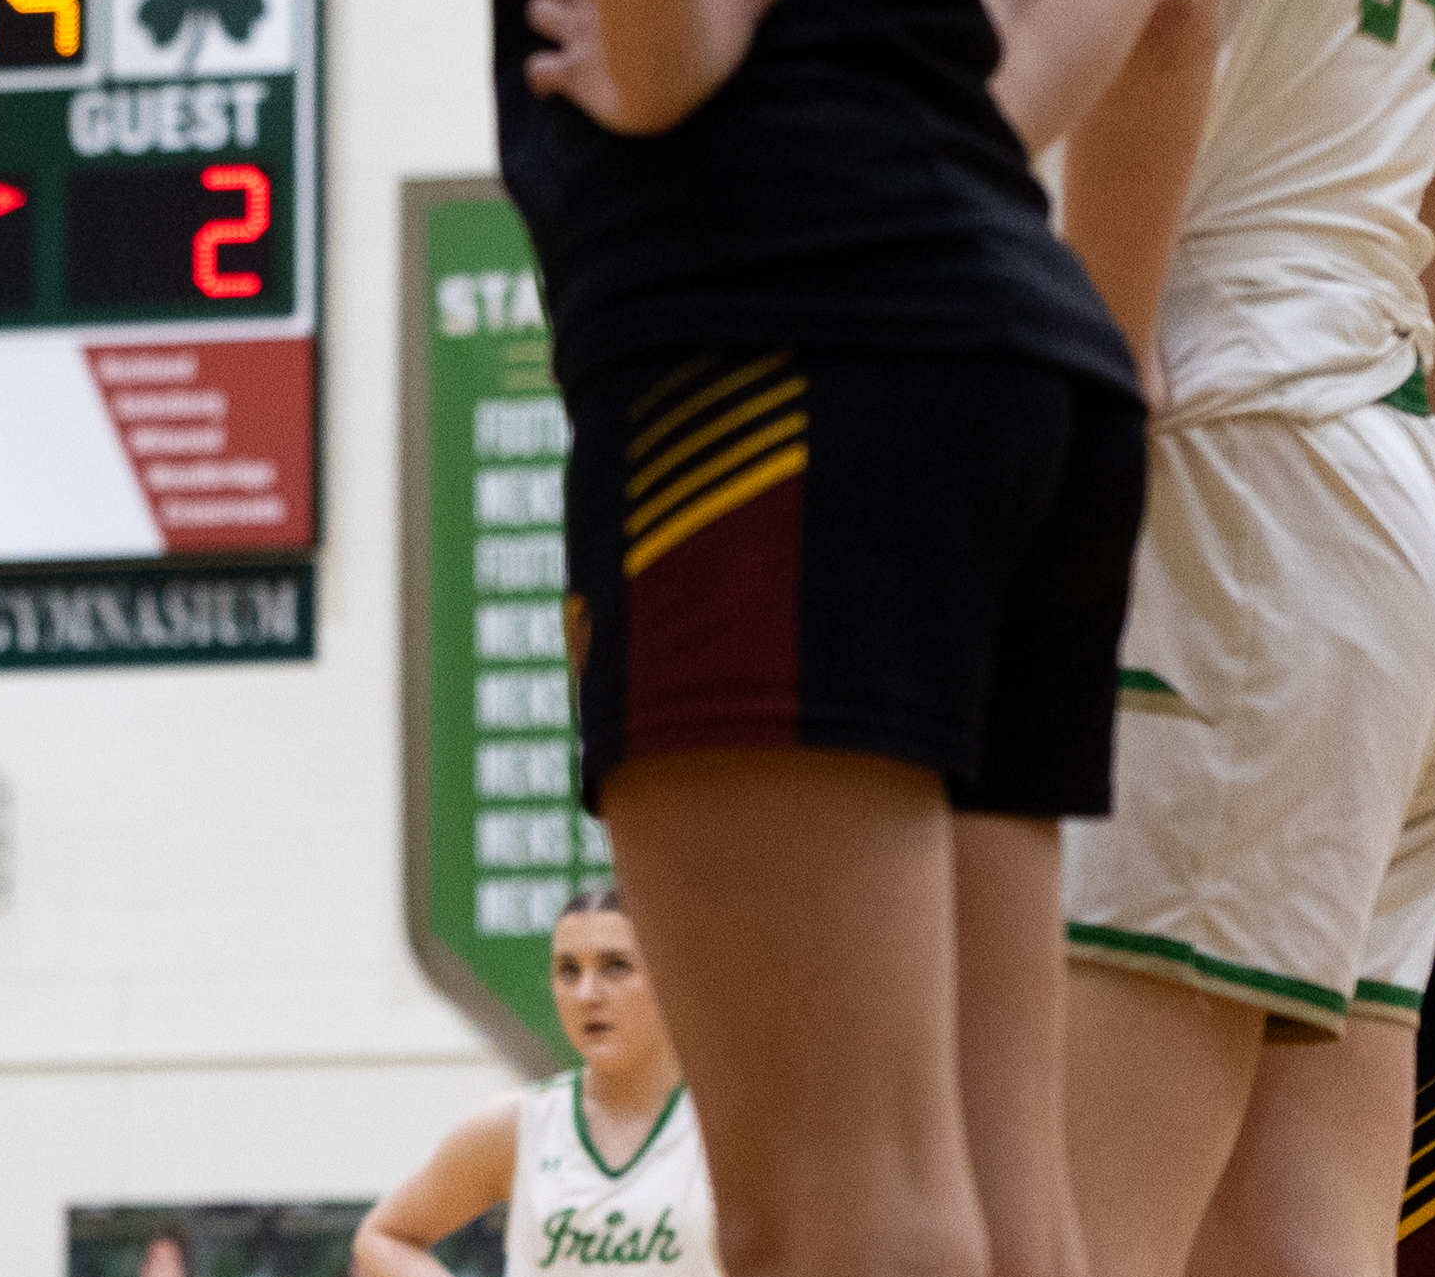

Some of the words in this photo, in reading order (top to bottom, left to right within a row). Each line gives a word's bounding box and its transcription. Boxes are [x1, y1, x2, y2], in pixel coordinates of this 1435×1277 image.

[69, 85, 269, 157] GUEST
[191, 162, 273, 300] 2
[435, 270, 547, 337] STA
[538, 1205, 684, 1269] Irish
